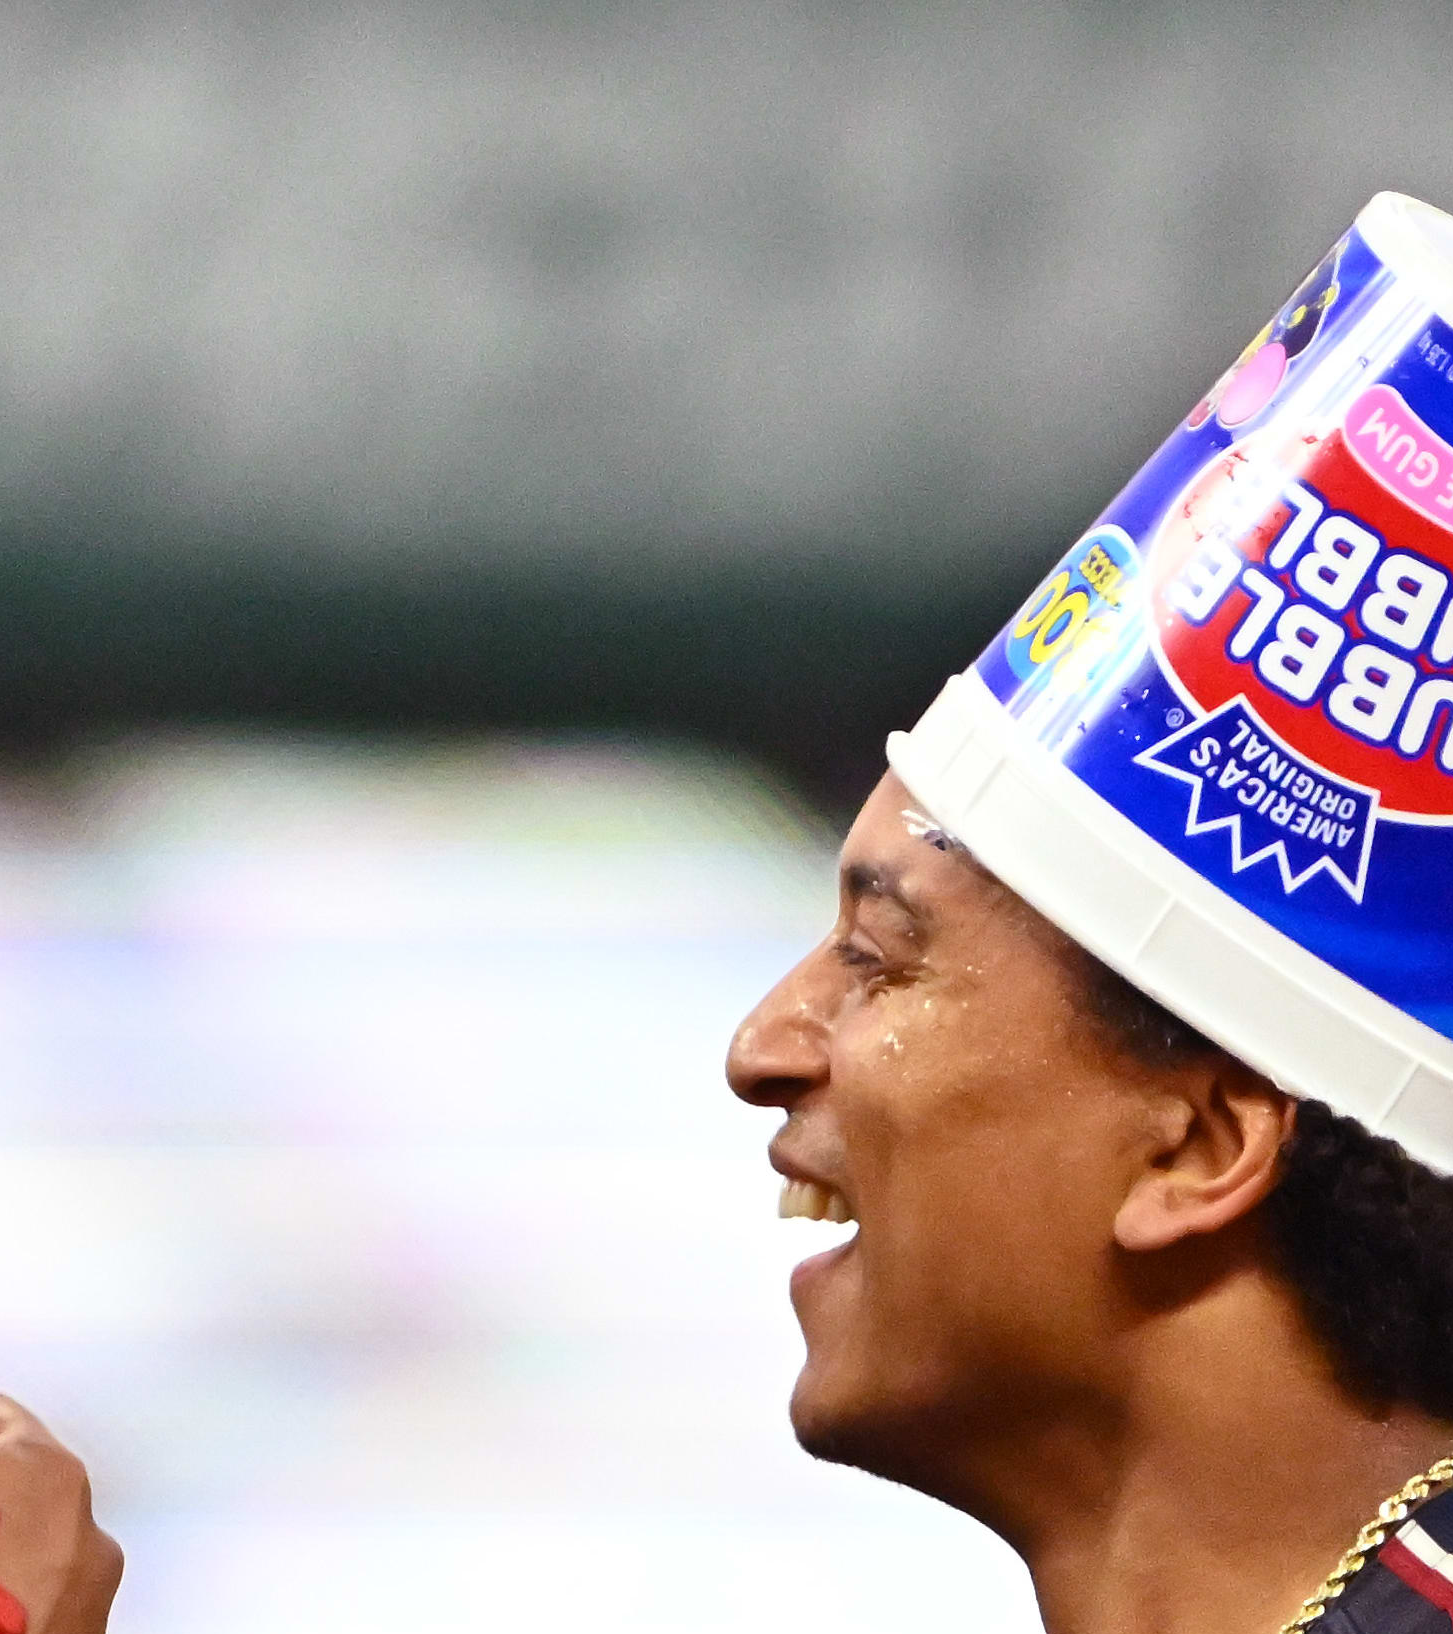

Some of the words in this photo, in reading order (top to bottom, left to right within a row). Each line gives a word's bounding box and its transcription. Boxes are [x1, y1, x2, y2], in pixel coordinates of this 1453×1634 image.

[1355, 405, 1439, 491] GUM
[1188, 736, 1356, 848] AMERICA'S
[1228, 718, 1355, 820] ORIGINAL
